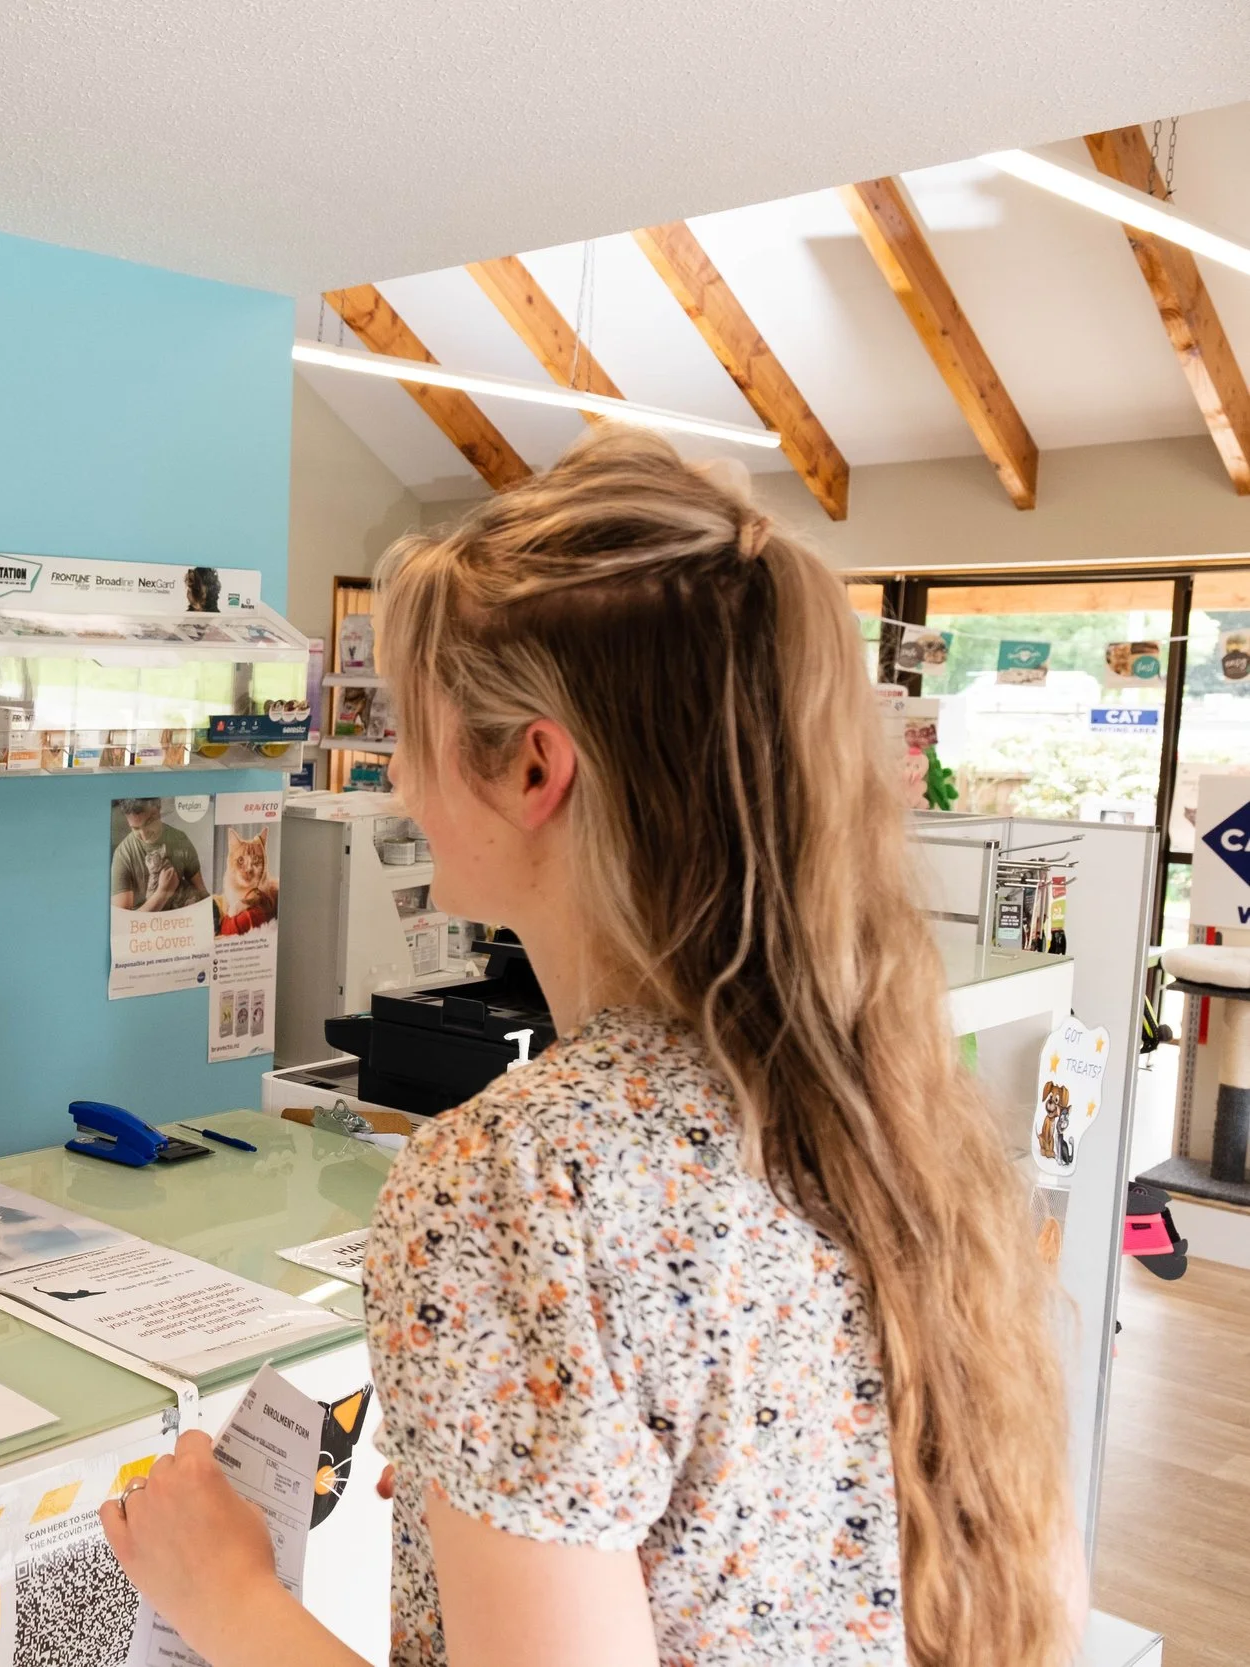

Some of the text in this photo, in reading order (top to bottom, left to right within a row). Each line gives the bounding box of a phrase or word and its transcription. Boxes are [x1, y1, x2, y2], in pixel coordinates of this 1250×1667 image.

[51, 572, 92, 584] FRONTLINE
[95, 576, 134, 587] Broadline
[138, 578, 176, 589] NexGard
[1105, 710, 1143, 724] CAT
[178, 802, 201, 811] Petplan
[244, 803, 279, 812] BRAVECTO
[130, 917, 194, 934] Be Clever.
[129, 936, 195, 954] Get Cover.
[115, 960, 145, 970] Responsible
[1064, 1027, 1083, 1043] GOT
[1066, 1058, 1102, 1079] TREATS?
[94, 1281, 232, 1323] We ask that you please leave
[107, 1286, 245, 1331] your cat with staff reception
[137, 1296, 262, 1338] admission process and not
[143, 1296, 235, 1328] after completing the
[162, 1304, 265, 1339] enter the main cattery
[204, 1318, 247, 1336] building.
[263, 1403, 295, 1431] ENROLMENT
[295, 1423, 310, 1440] FORM
[24, 1509, 100, 1542] SCAN HERE TO SIGN
[29, 1526, 83, 1552] THE NZ COVID
